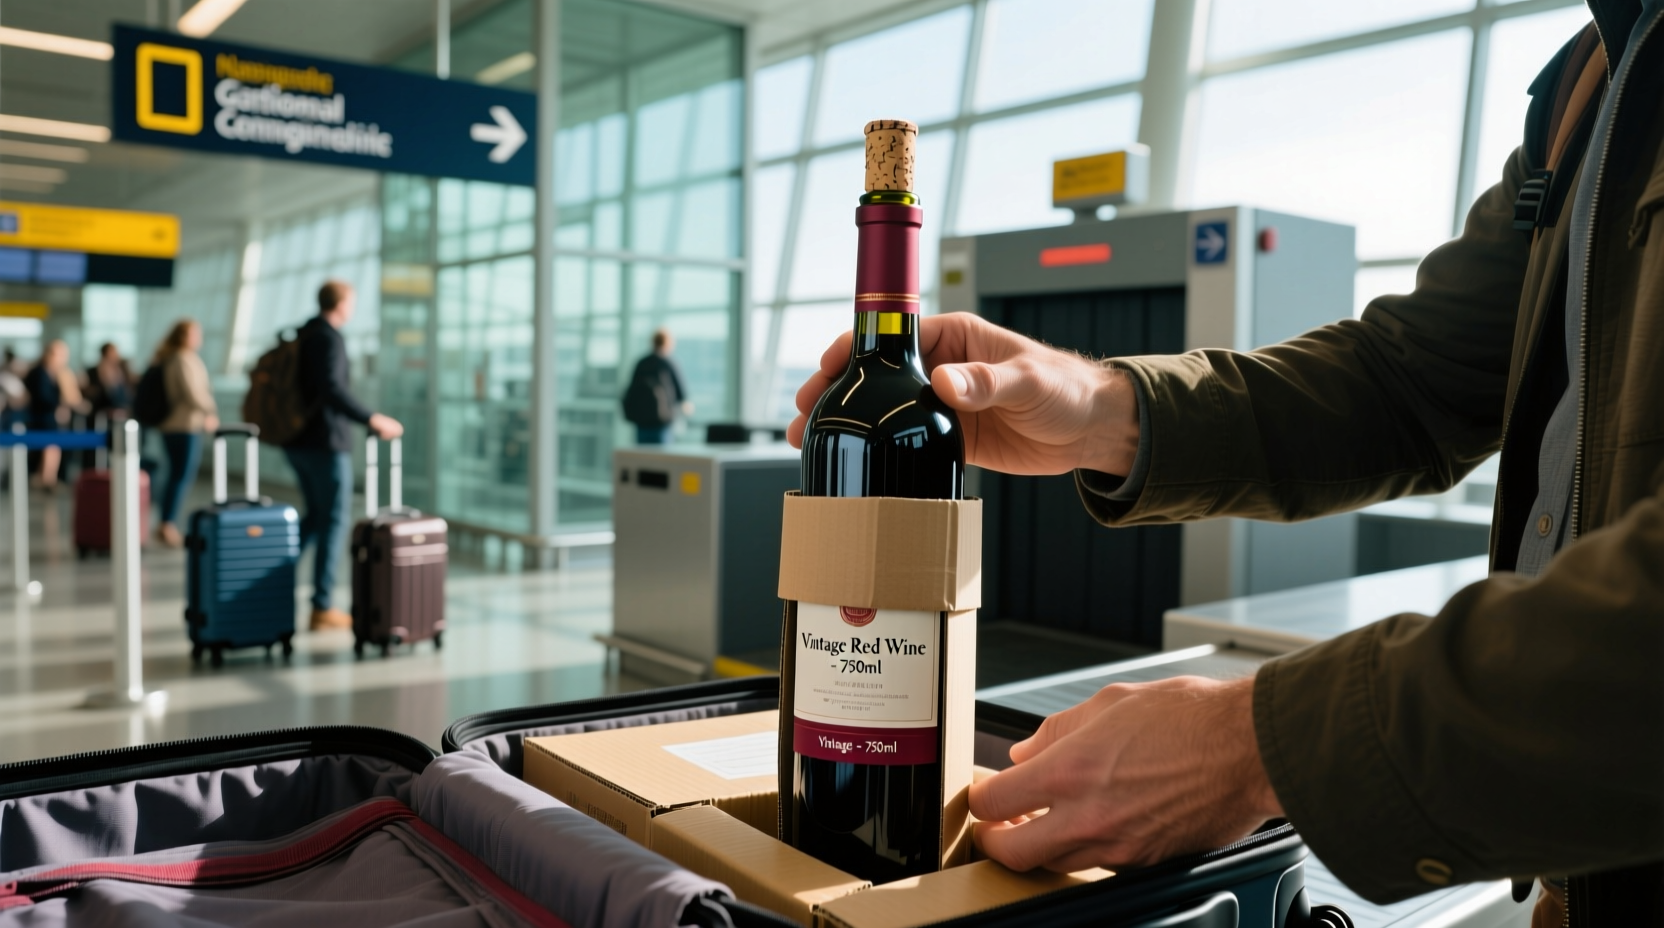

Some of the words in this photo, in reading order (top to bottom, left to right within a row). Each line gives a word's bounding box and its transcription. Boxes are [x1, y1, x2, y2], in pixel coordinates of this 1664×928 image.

[850, 637, 881, 654] Red
[884, 638, 927, 656] Wine
[839, 658, 882, 675] 750ml
[865, 740, 897, 753] 750ml
